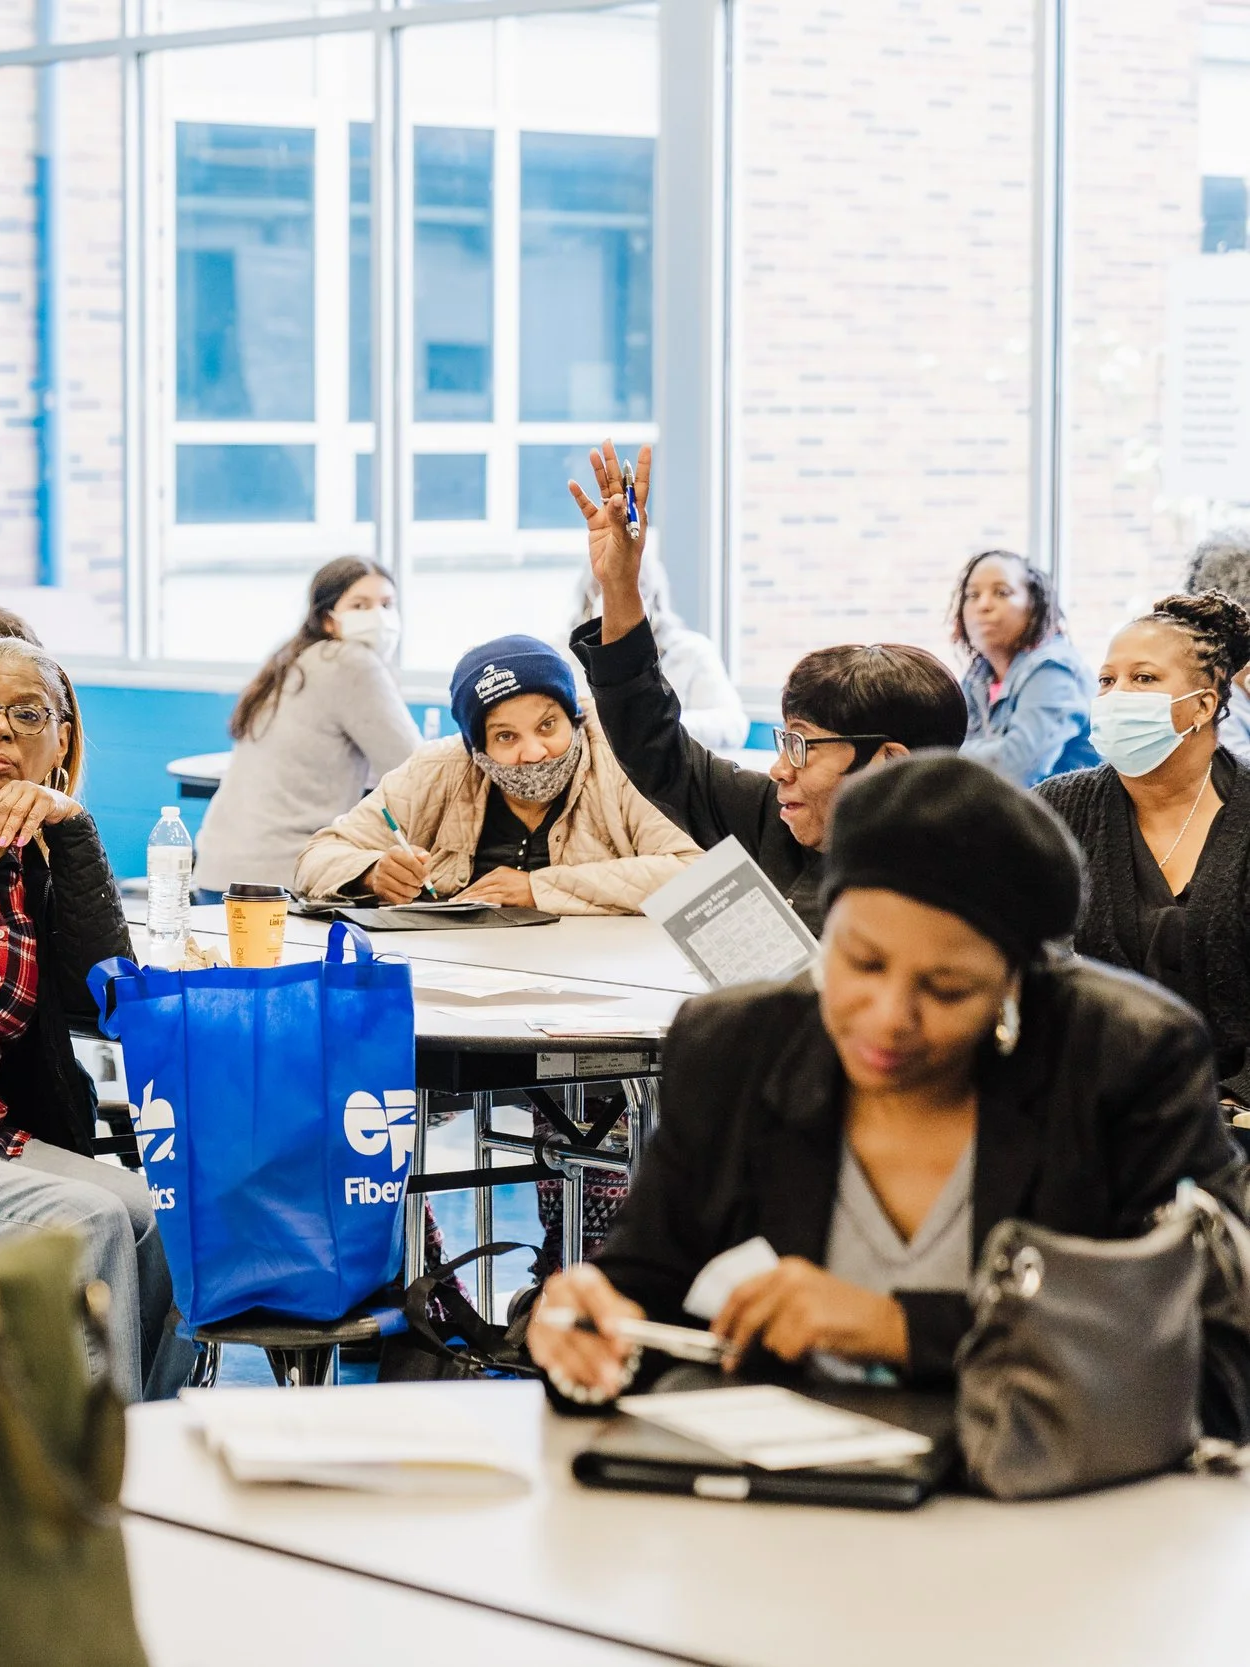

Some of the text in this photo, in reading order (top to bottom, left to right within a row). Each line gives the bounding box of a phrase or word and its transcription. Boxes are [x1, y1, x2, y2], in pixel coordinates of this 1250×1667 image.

[684, 879, 739, 922] Money School
[703, 897, 730, 918] Bingo
[150, 1183, 176, 1211] tics
[344, 1177, 402, 1205] Fiber
